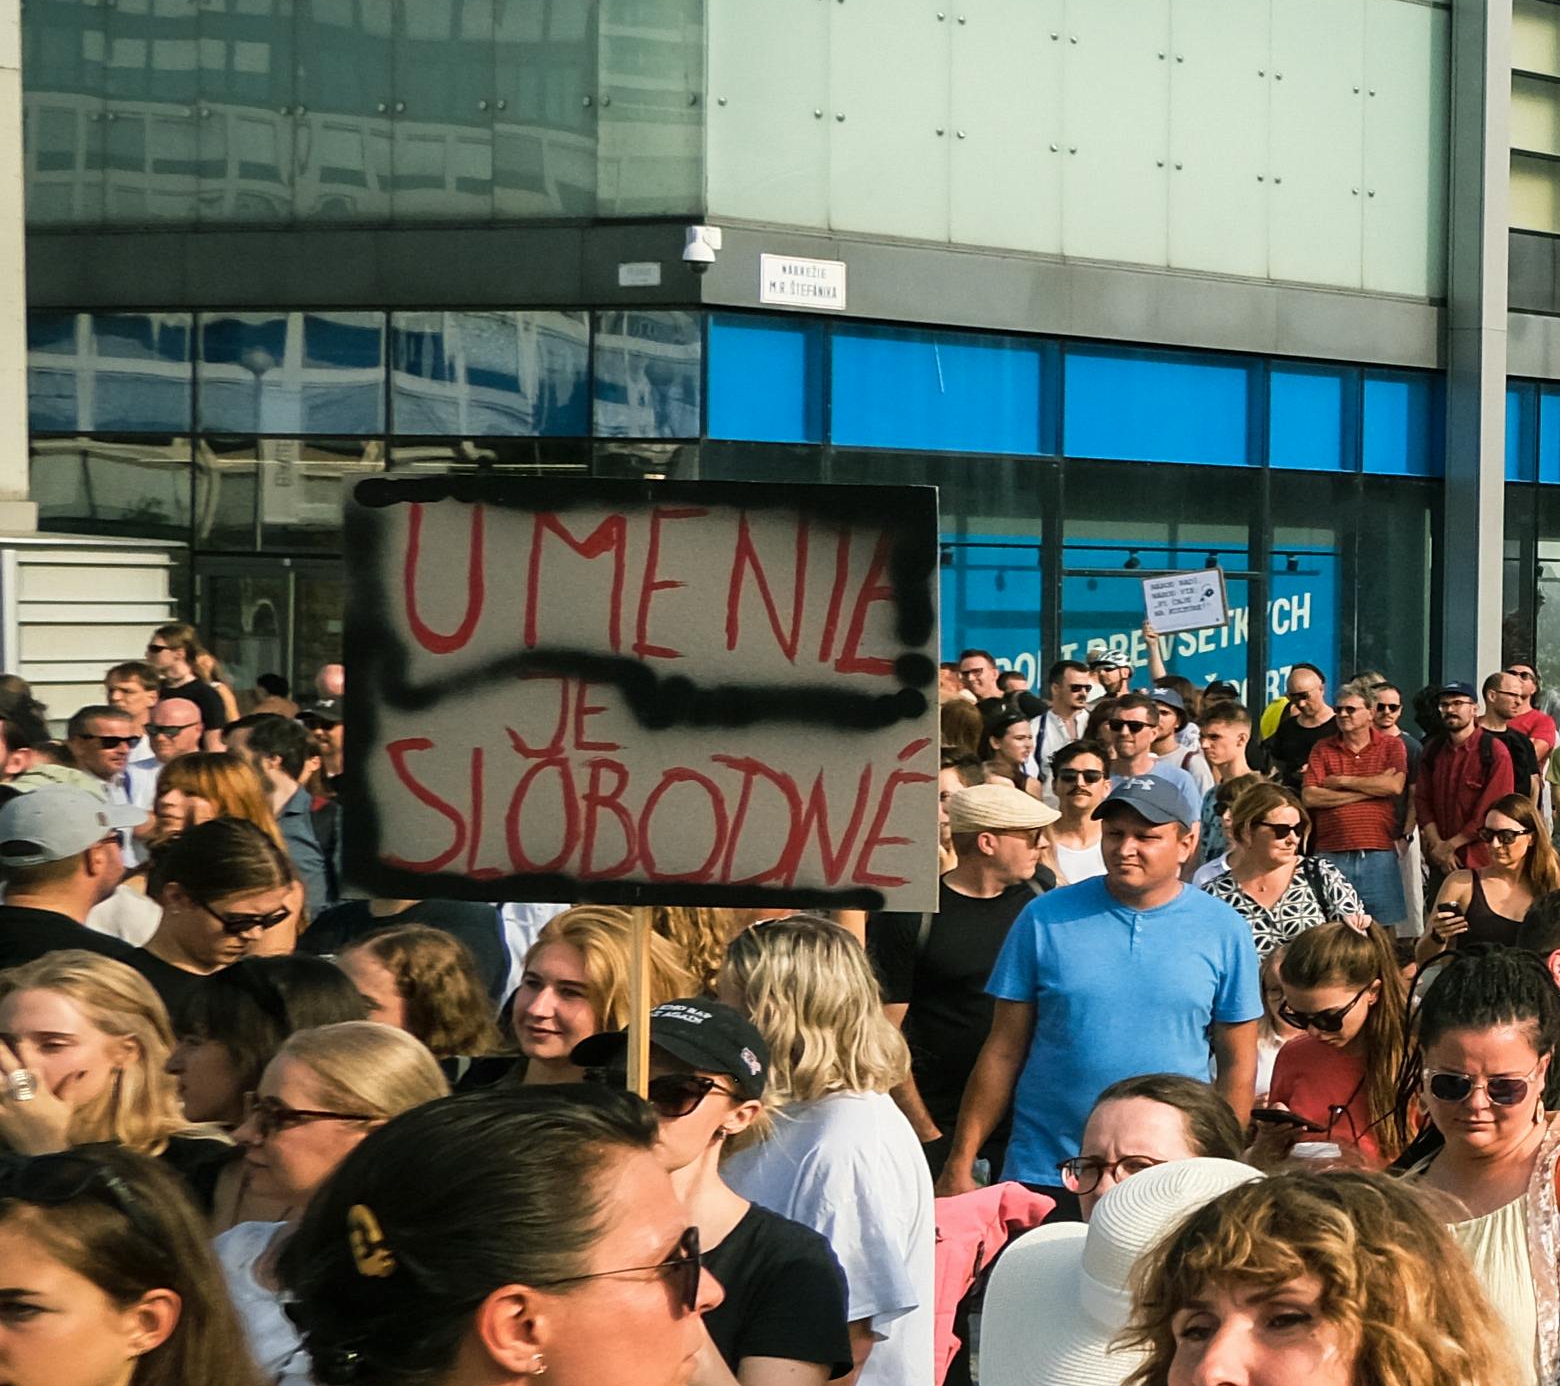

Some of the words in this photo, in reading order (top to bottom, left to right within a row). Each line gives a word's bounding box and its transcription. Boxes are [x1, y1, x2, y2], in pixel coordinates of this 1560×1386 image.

[405, 503, 898, 676] UMENIE
[505, 673, 629, 759] JE
[376, 737, 938, 888] SLOBODNÉ
